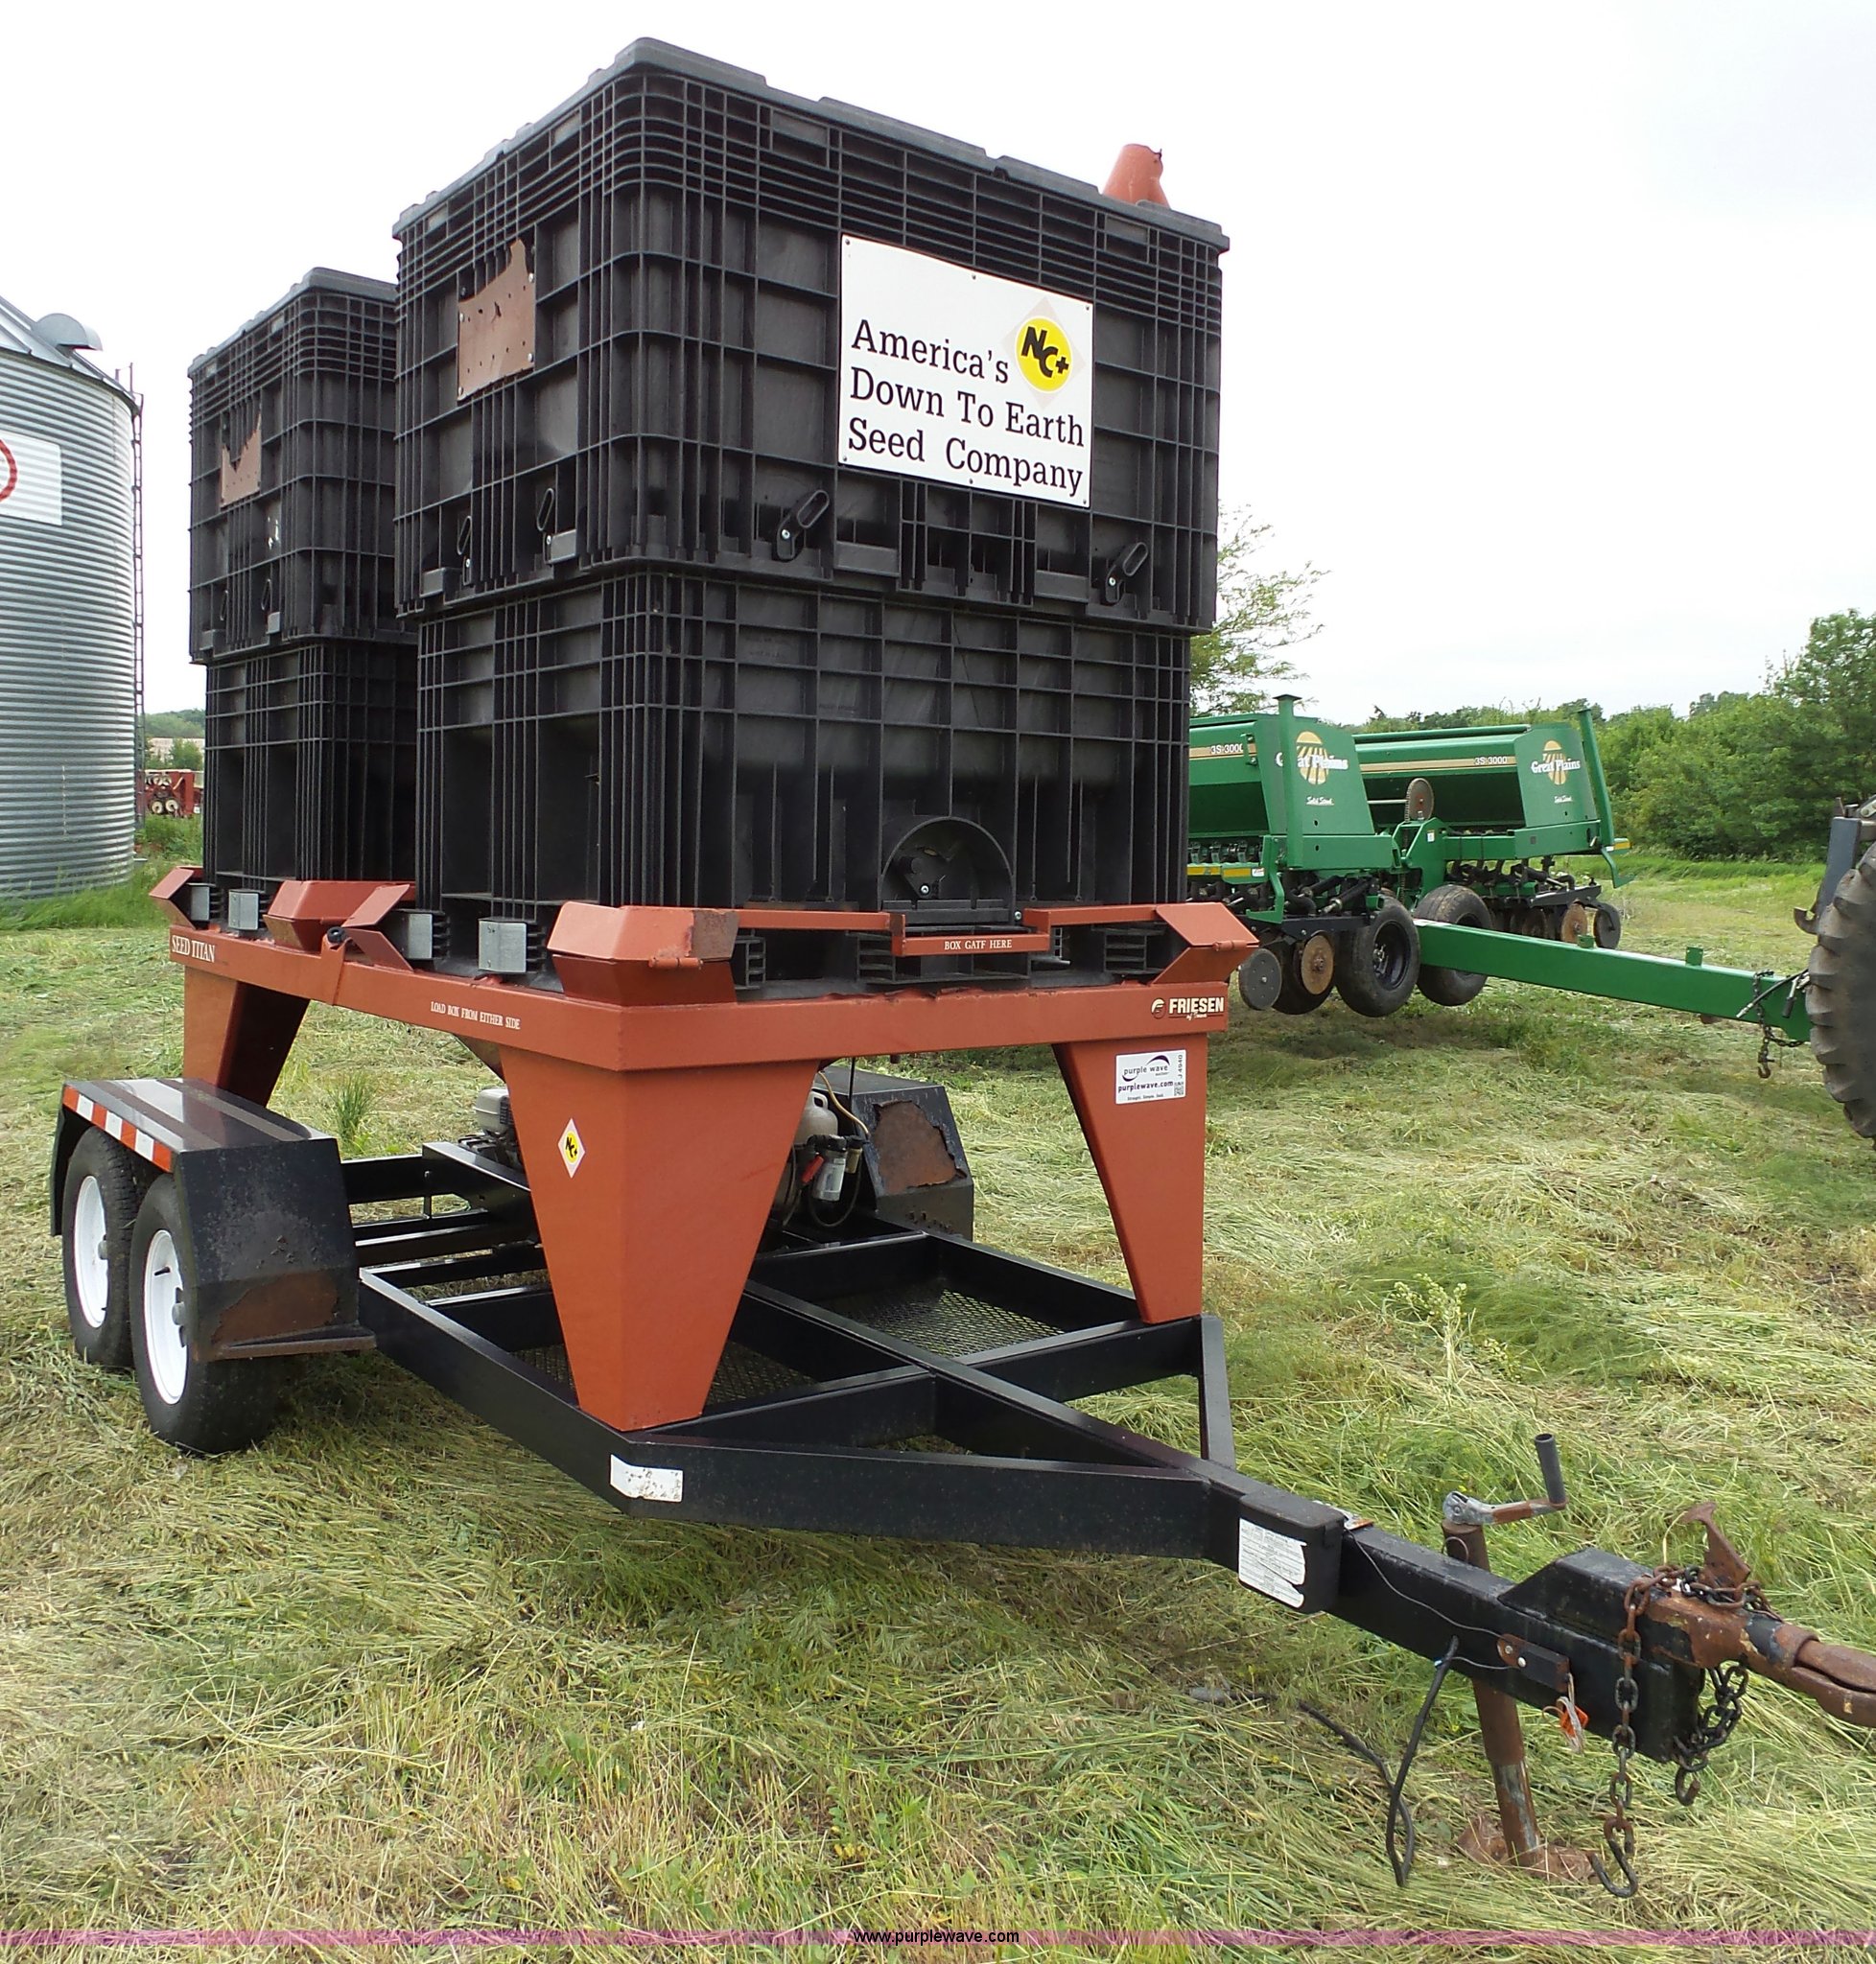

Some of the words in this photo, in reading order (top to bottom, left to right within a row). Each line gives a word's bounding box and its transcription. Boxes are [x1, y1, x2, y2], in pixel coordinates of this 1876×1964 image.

[851, 319, 1009, 384] America's
[850, 366, 945, 417] Down
[957, 390, 994, 428] To
[1005, 401, 1085, 447] Earth
[848, 416, 925, 462] Seed
[946, 436, 1084, 497] Company
[1531, 760, 1555, 773] Great
[1555, 759, 1581, 771] Plains
[172, 934, 191, 956] SEED
[191, 940, 216, 963] TITAN
[944, 940, 962, 950] BOX
[989, 939, 1013, 948] HERE
[431, 1000, 446, 1014] LOAD
[447, 1004, 460, 1017] BOX
[460, 1007, 479, 1021] FROM
[480, 1011, 504, 1026] EITHER
[504, 1017, 521, 1030] SIDE
[1169, 997, 1225, 1014] FRIESEN
[1124, 1065, 1147, 1075] purple
[1118, 1081, 1173, 1092] purplewave.com
